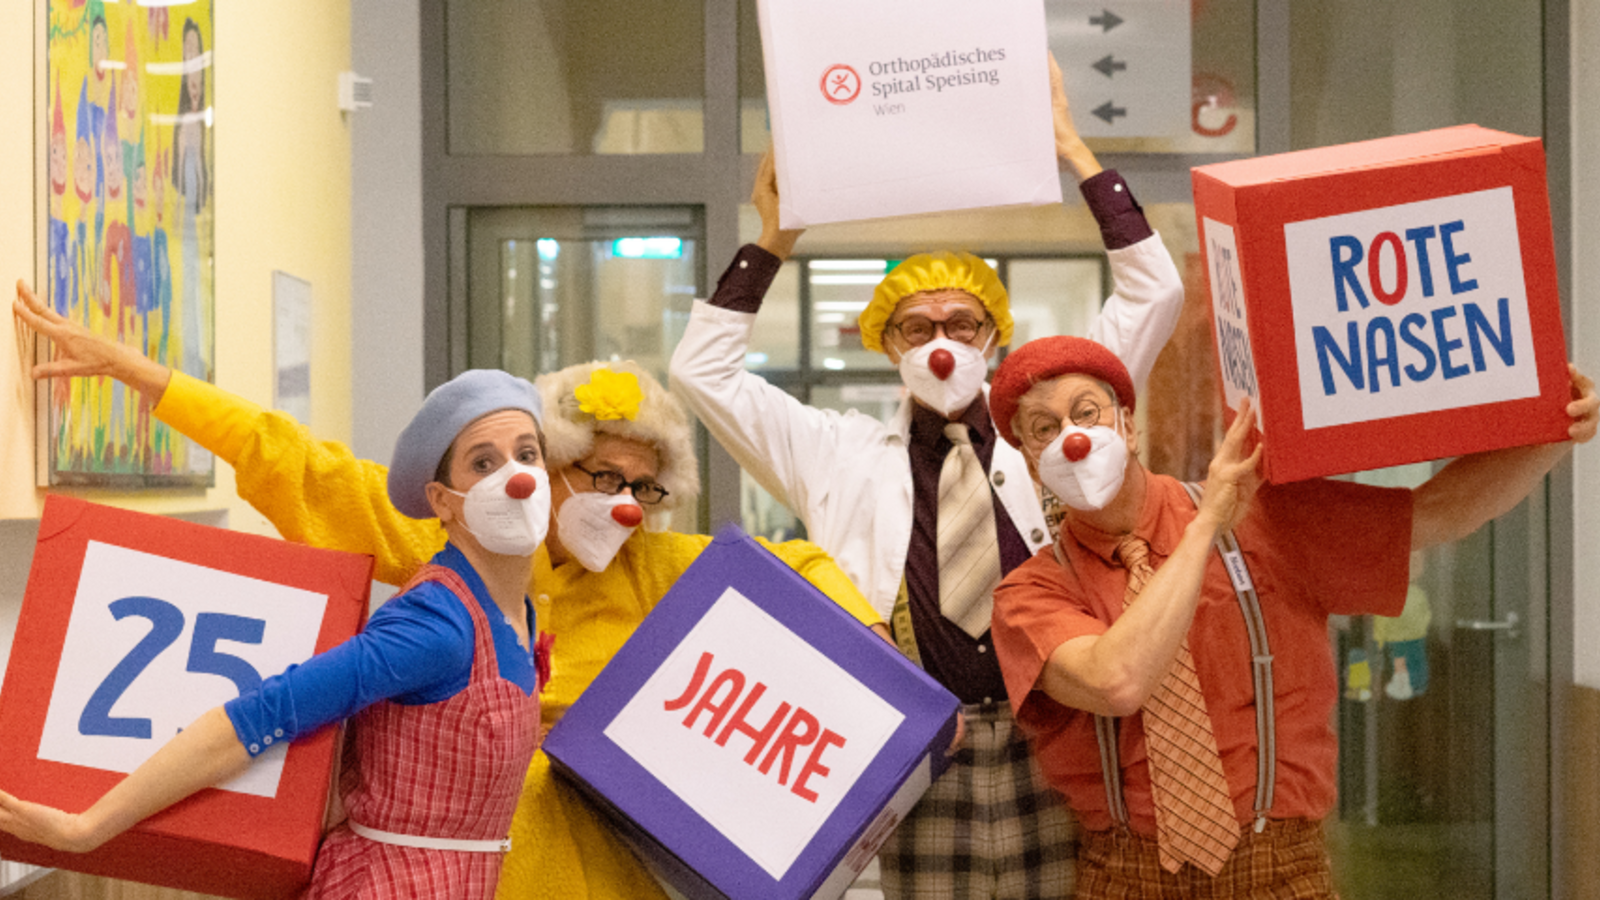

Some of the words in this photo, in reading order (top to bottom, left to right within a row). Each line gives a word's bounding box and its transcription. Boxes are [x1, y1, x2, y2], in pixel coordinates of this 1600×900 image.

[868, 47, 1006, 76] Orthopädisches
[871, 76, 921, 98] Spital
[925, 69, 1000, 92] Speising
[872, 102, 905, 117] Wien
[1329, 220, 1479, 313] ROTE
[1311, 298, 1515, 396] NASEN
[78, 596, 266, 739] 25
[664, 651, 847, 803] JAHRE
